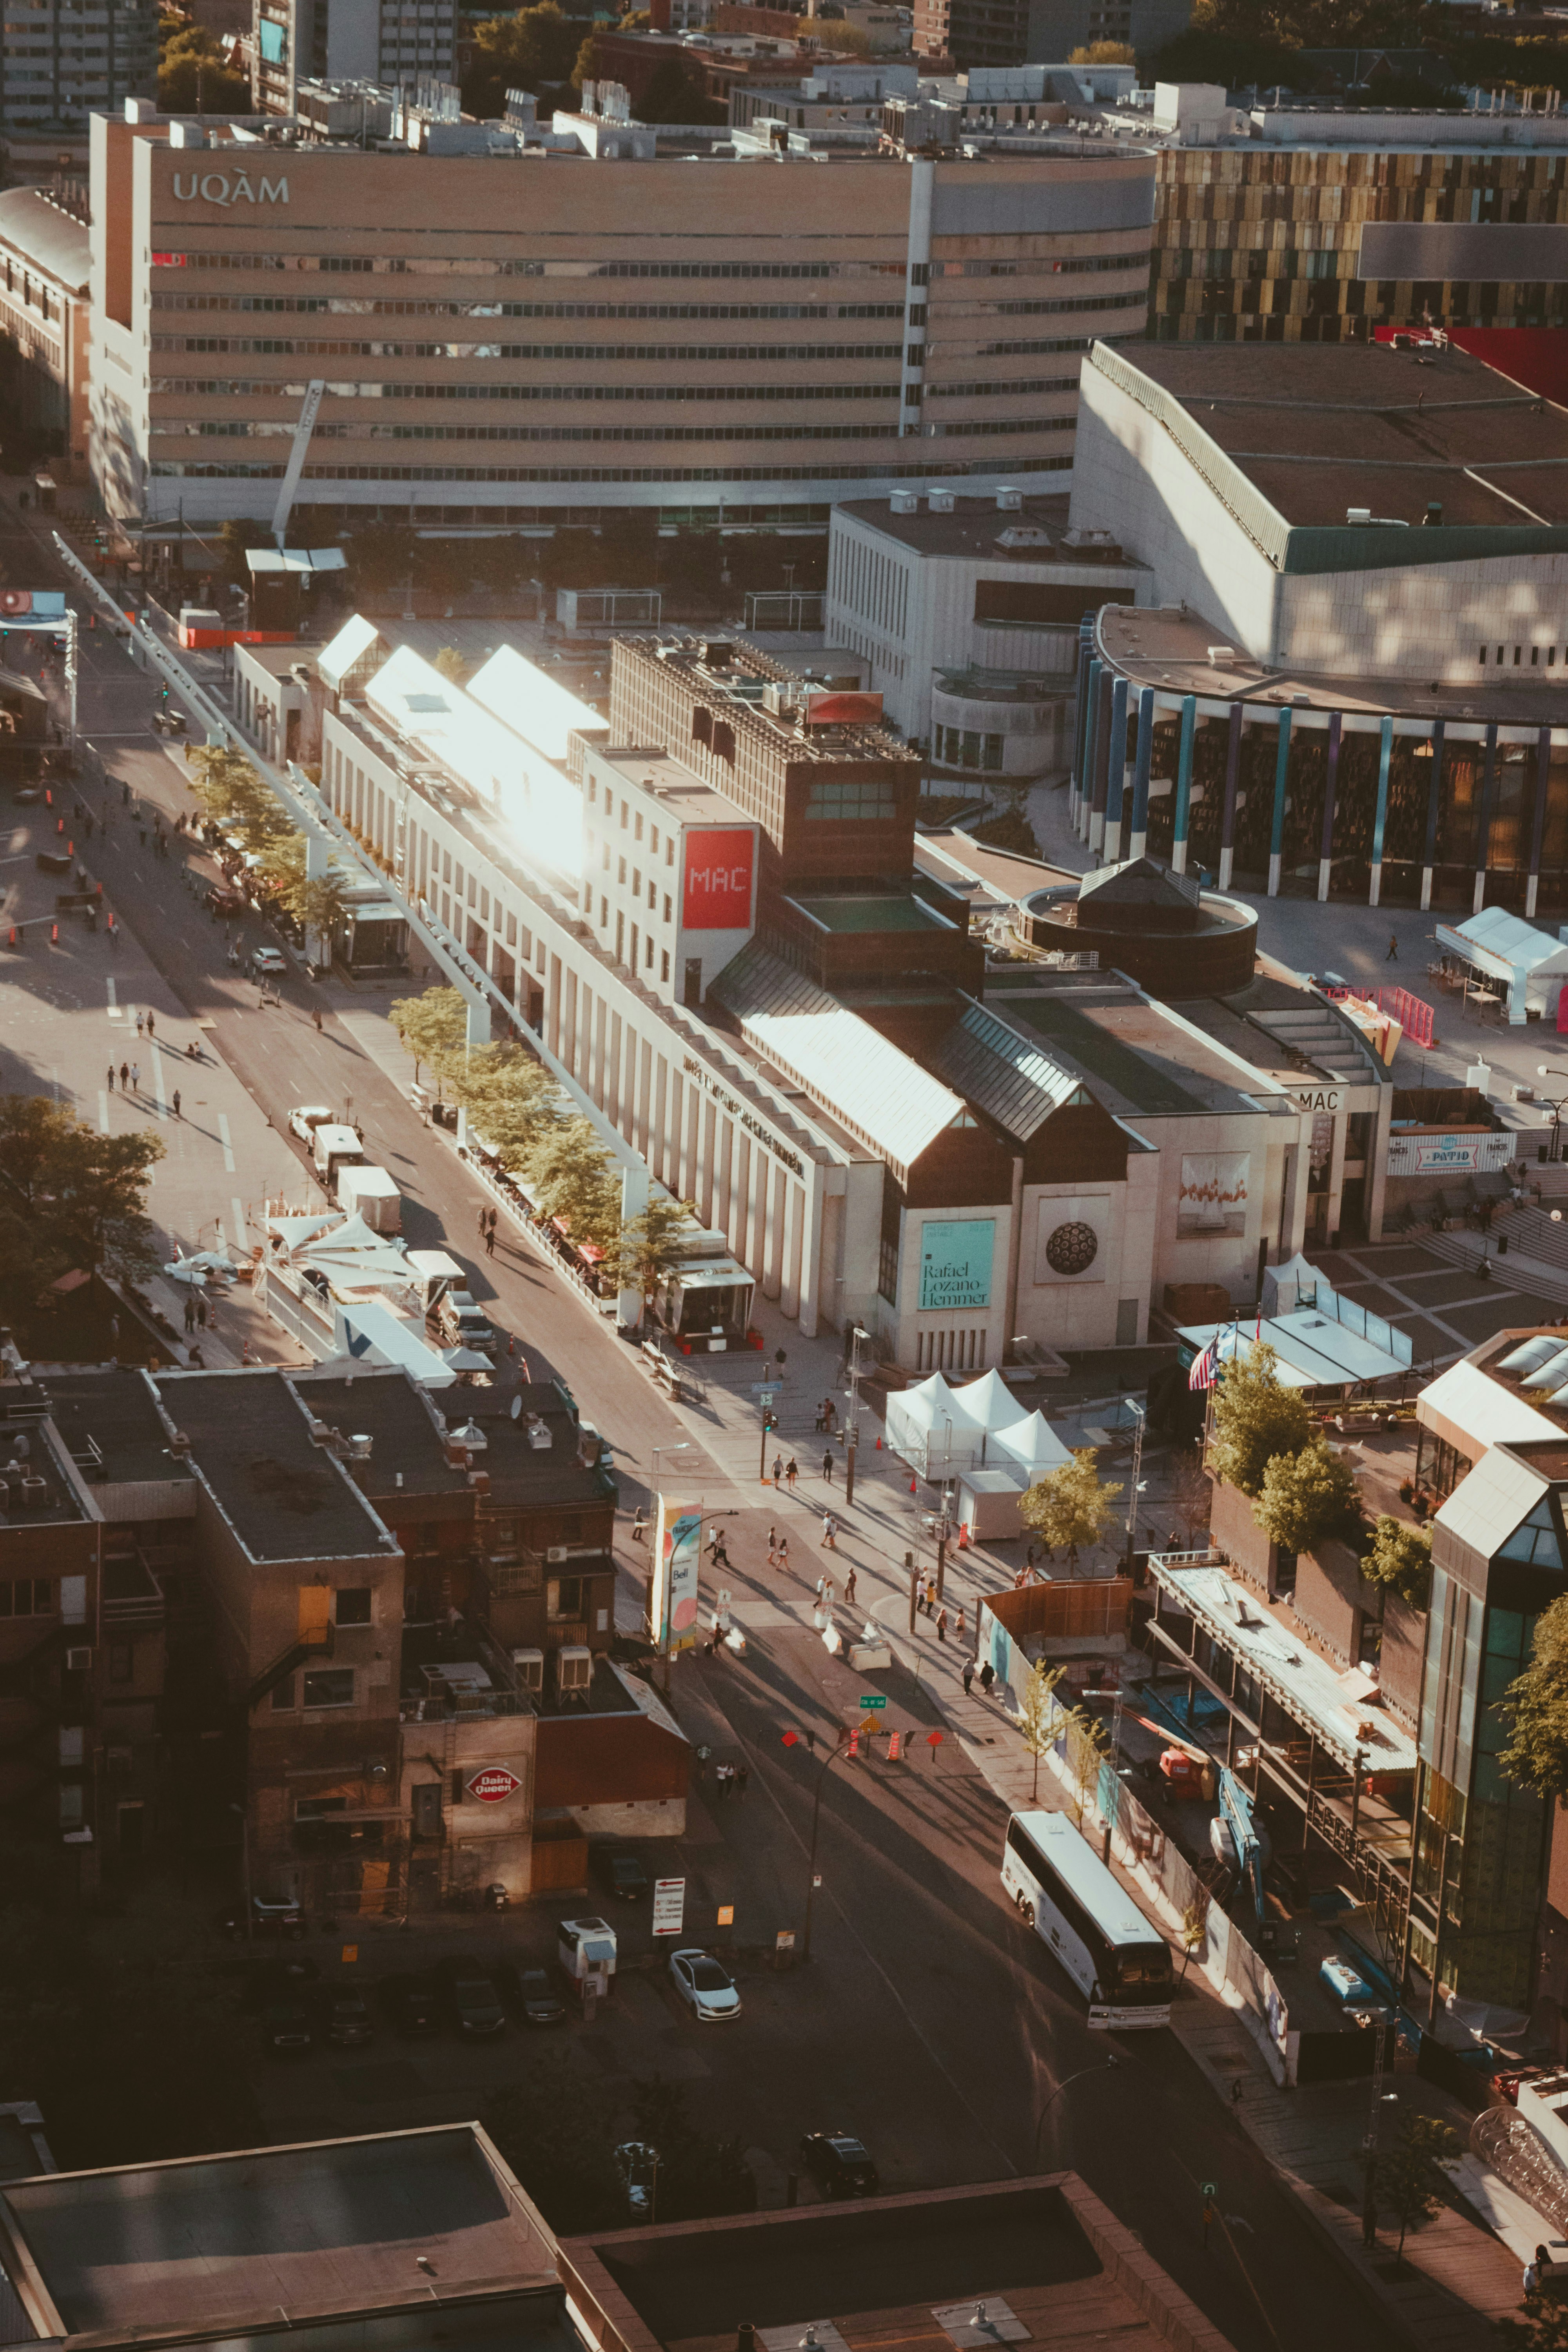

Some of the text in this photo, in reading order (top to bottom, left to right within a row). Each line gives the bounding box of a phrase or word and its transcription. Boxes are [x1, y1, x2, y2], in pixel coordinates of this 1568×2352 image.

[173, 167, 290, 207] UQÀM
[690, 867, 747, 893] MAC
[1299, 1091, 1338, 1110] MAC
[1487, 1143, 1508, 1151] FRANCOS
[1432, 1151, 1469, 1161] PATIO
[924, 1261, 968, 1278] Rafael
[922, 1292, 987, 1306] Hemmer
[673, 1568, 688, 1580] Bell
[481, 1775, 512, 1785] Dairy
[475, 1785, 512, 1795] Queen
